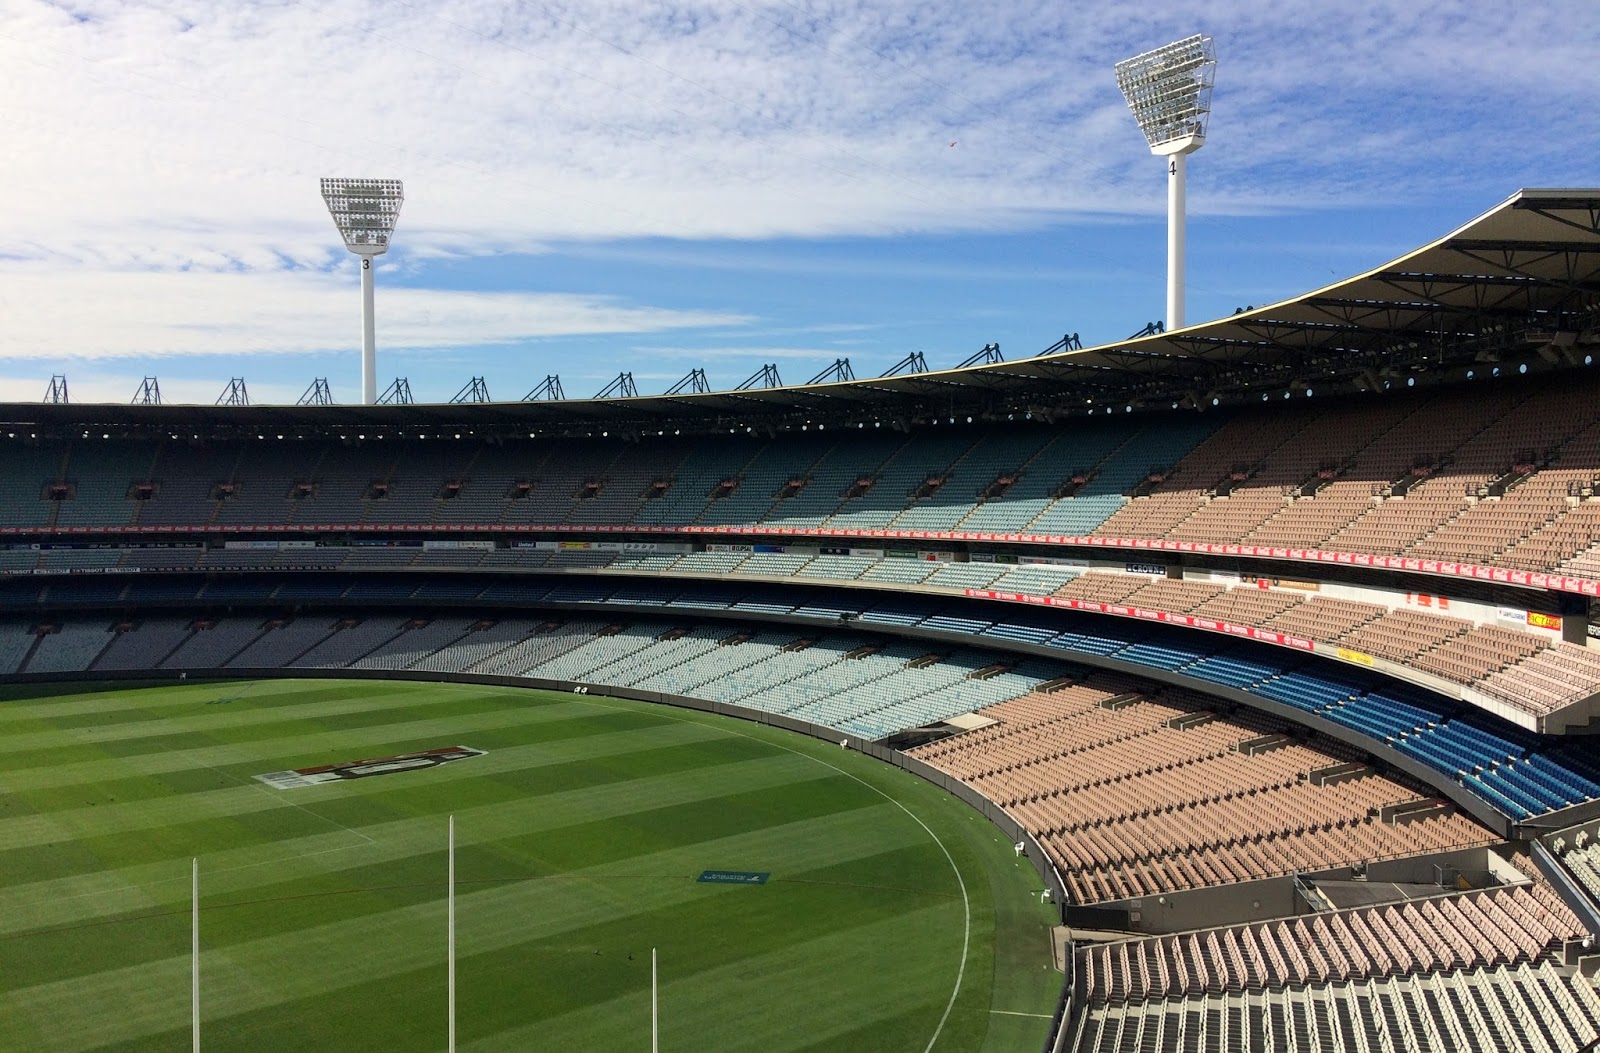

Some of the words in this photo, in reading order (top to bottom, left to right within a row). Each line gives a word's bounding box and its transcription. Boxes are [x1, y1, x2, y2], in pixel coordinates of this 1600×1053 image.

[1169, 161, 1177, 175] 4
[362, 259, 370, 270] 3
[1133, 565, 1159, 573] CROWN
